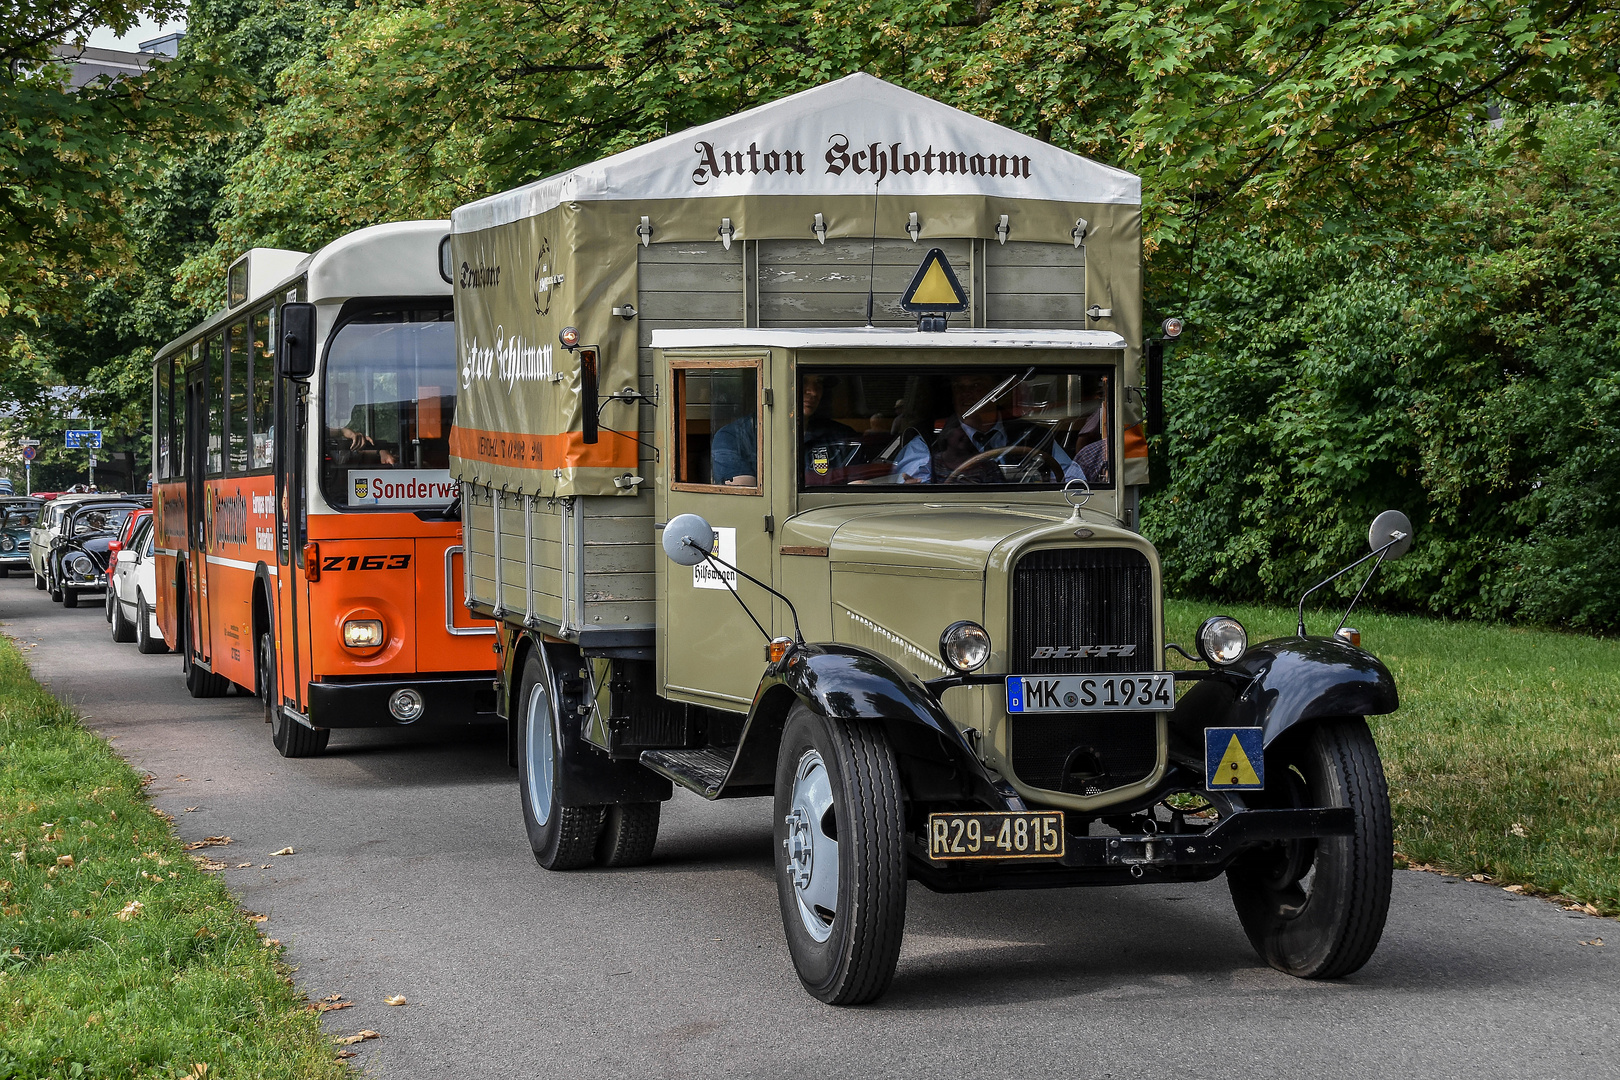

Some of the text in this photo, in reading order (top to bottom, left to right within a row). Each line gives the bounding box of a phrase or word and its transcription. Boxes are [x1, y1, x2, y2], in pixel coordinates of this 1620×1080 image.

[692, 133, 1032, 186] Anton Schlotmann
[322, 554, 412, 572] Z163
[1031, 644, 1137, 659] BLITZ
[1026, 680, 1062, 708] MK
[1080, 679, 1097, 706] S
[1102, 678, 1170, 706] 1934
[933, 817, 1058, 853] R29-4815
